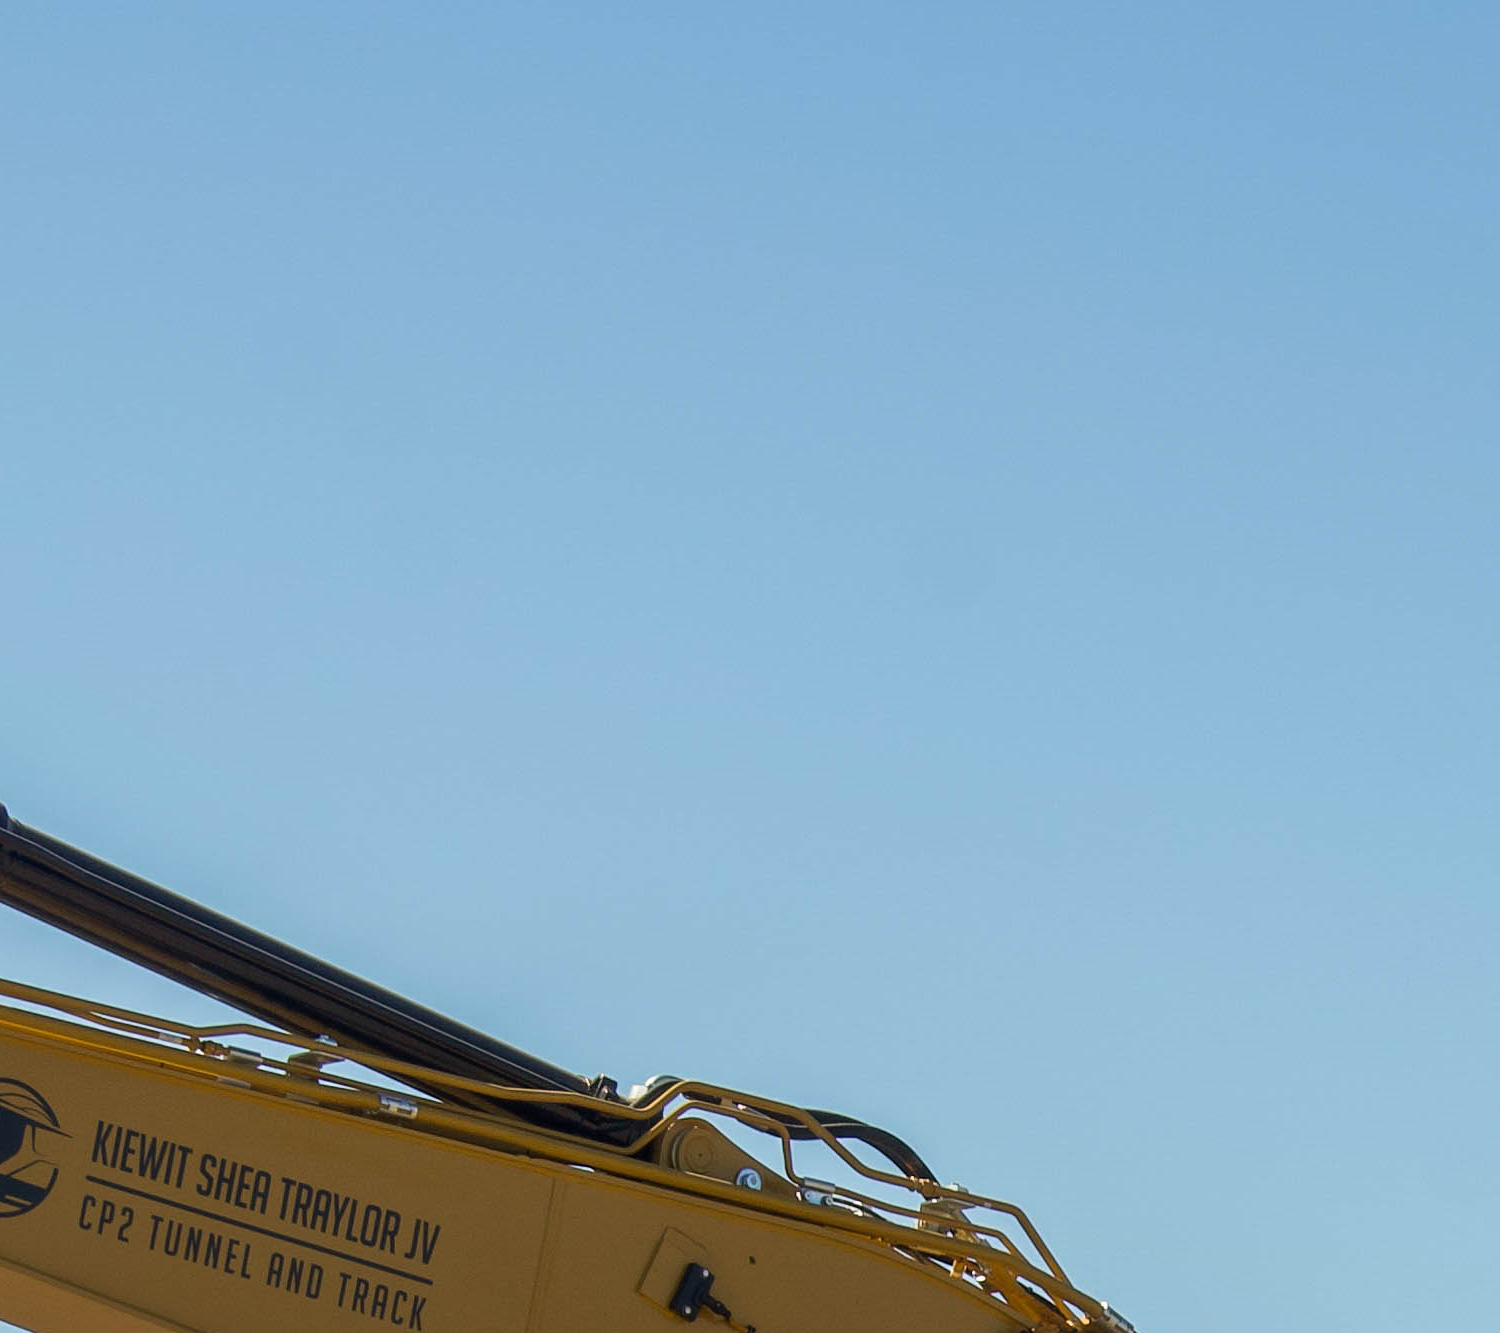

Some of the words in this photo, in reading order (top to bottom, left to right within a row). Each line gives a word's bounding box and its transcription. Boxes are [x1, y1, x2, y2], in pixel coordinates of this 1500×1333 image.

[79, 1194, 134, 1243] CP2
[149, 1214, 251, 1279] TUNNEL
[266, 1252, 324, 1299] AND
[338, 1272, 427, 1331] TRACK
[91, 1120, 193, 1188] KIEWIT
[196, 1153, 271, 1214] SHEA
[279, 1177, 401, 1254] TRAYLOR
[404, 1218, 441, 1265] JV
